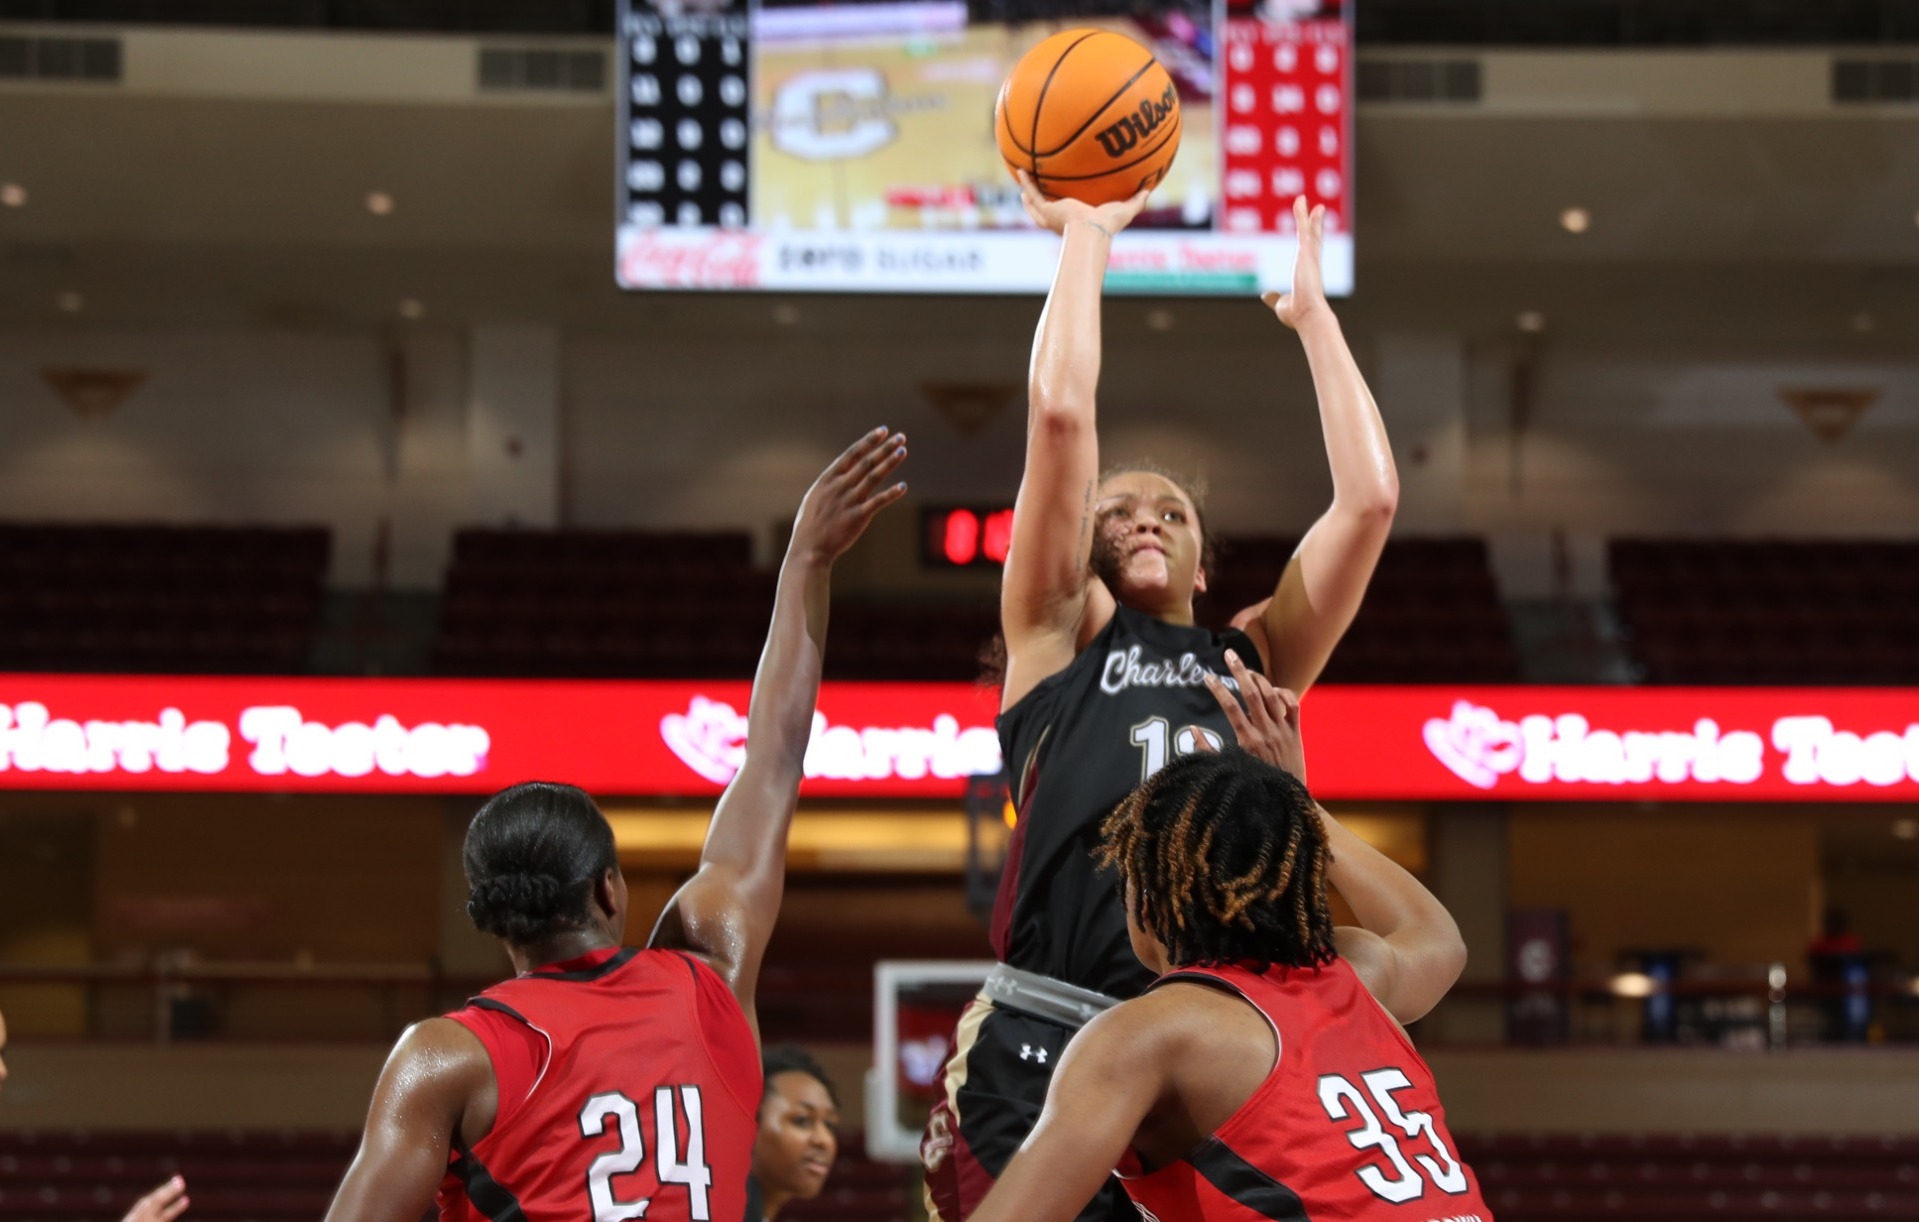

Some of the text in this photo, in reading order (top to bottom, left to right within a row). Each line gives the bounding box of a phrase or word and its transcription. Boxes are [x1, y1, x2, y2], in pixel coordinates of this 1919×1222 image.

[1100, 645, 1240, 694] Charle
[1518, 713, 1764, 784] Harris
[577, 1084, 713, 1222] 24
[1316, 1066, 1469, 1206] 35
